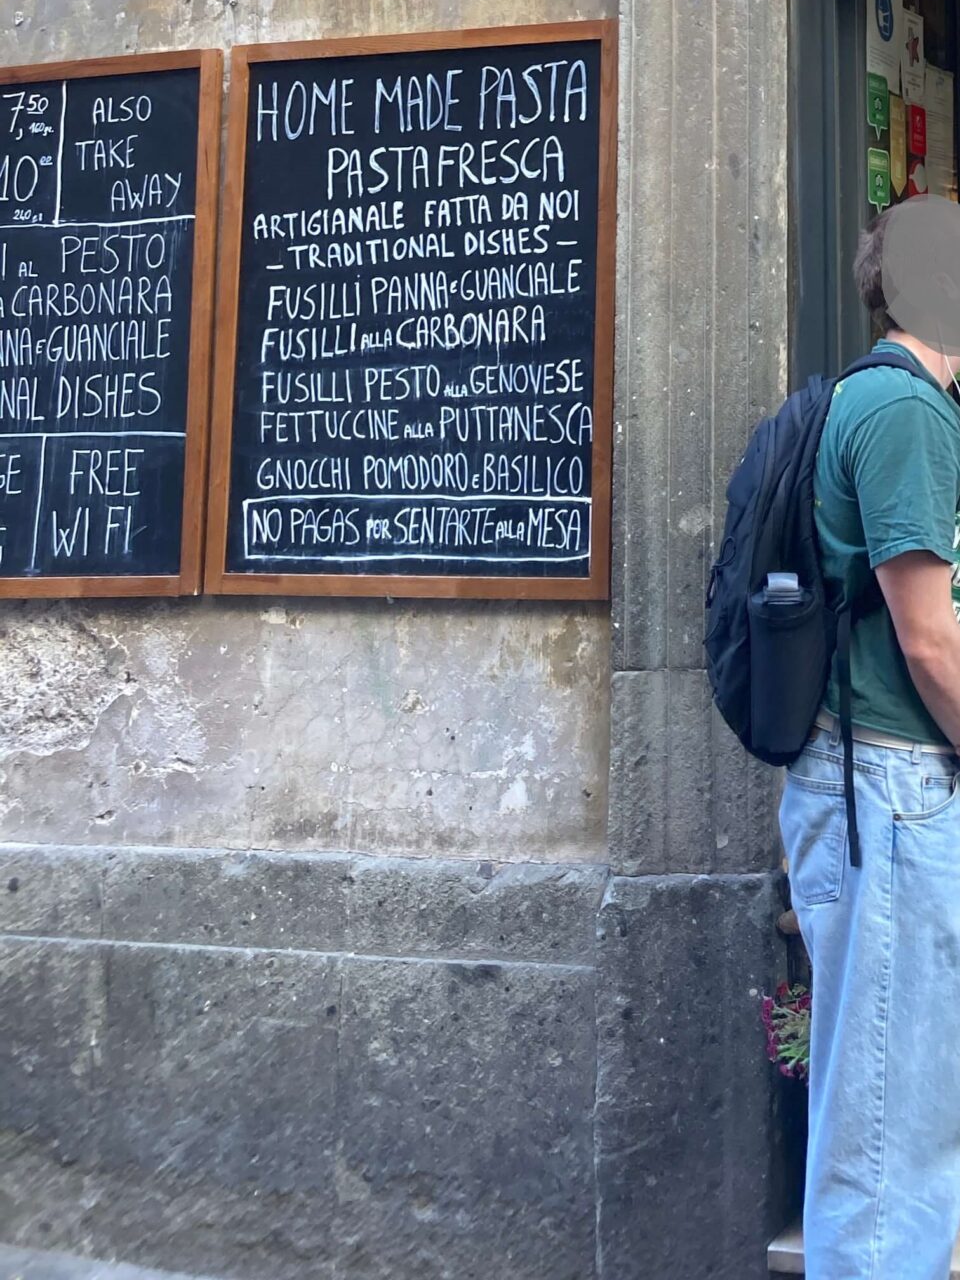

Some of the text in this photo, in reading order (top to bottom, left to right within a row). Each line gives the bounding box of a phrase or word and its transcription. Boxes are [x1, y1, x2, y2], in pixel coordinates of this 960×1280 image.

[92, 95, 152, 125] ALSO
[257, 59, 586, 142] HOME MADE PASTA
[75, 135, 136, 170] TAKE
[327, 135, 564, 200] PASTA FRESCA
[111, 173, 182, 213] AWAY
[253, 189, 580, 240] ARTIGIANALE FATTA DA NOI
[19, 234, 165, 277] AL PESTO
[12, 275, 172, 316] CARBONARA
[372, 271, 447, 315] PANNA
[460, 259, 582, 302] GUANCIALE
[47, 319, 171, 362] GUANCIALE
[261, 308, 546, 362] FUSILLI ALLA CARBONARA
[57, 372, 161, 419] DISHES
[262, 359, 583, 404] FUSILLI PESTO ALLA GENOVESE
[261, 403, 593, 445] FETTUCCINE ALLA PUTTANESCA
[70, 449, 144, 495] FREE
[257, 458, 350, 490] GNOCCHI
[364, 452, 468, 492] POMODORO
[483, 456, 583, 497] BASILICO
[253, 508, 282, 545] NO
[291, 508, 360, 545] PAGAS
[366, 518, 392, 540] POR
[394, 507, 495, 545] SENTARTE
[527, 508, 581, 550] MESA
